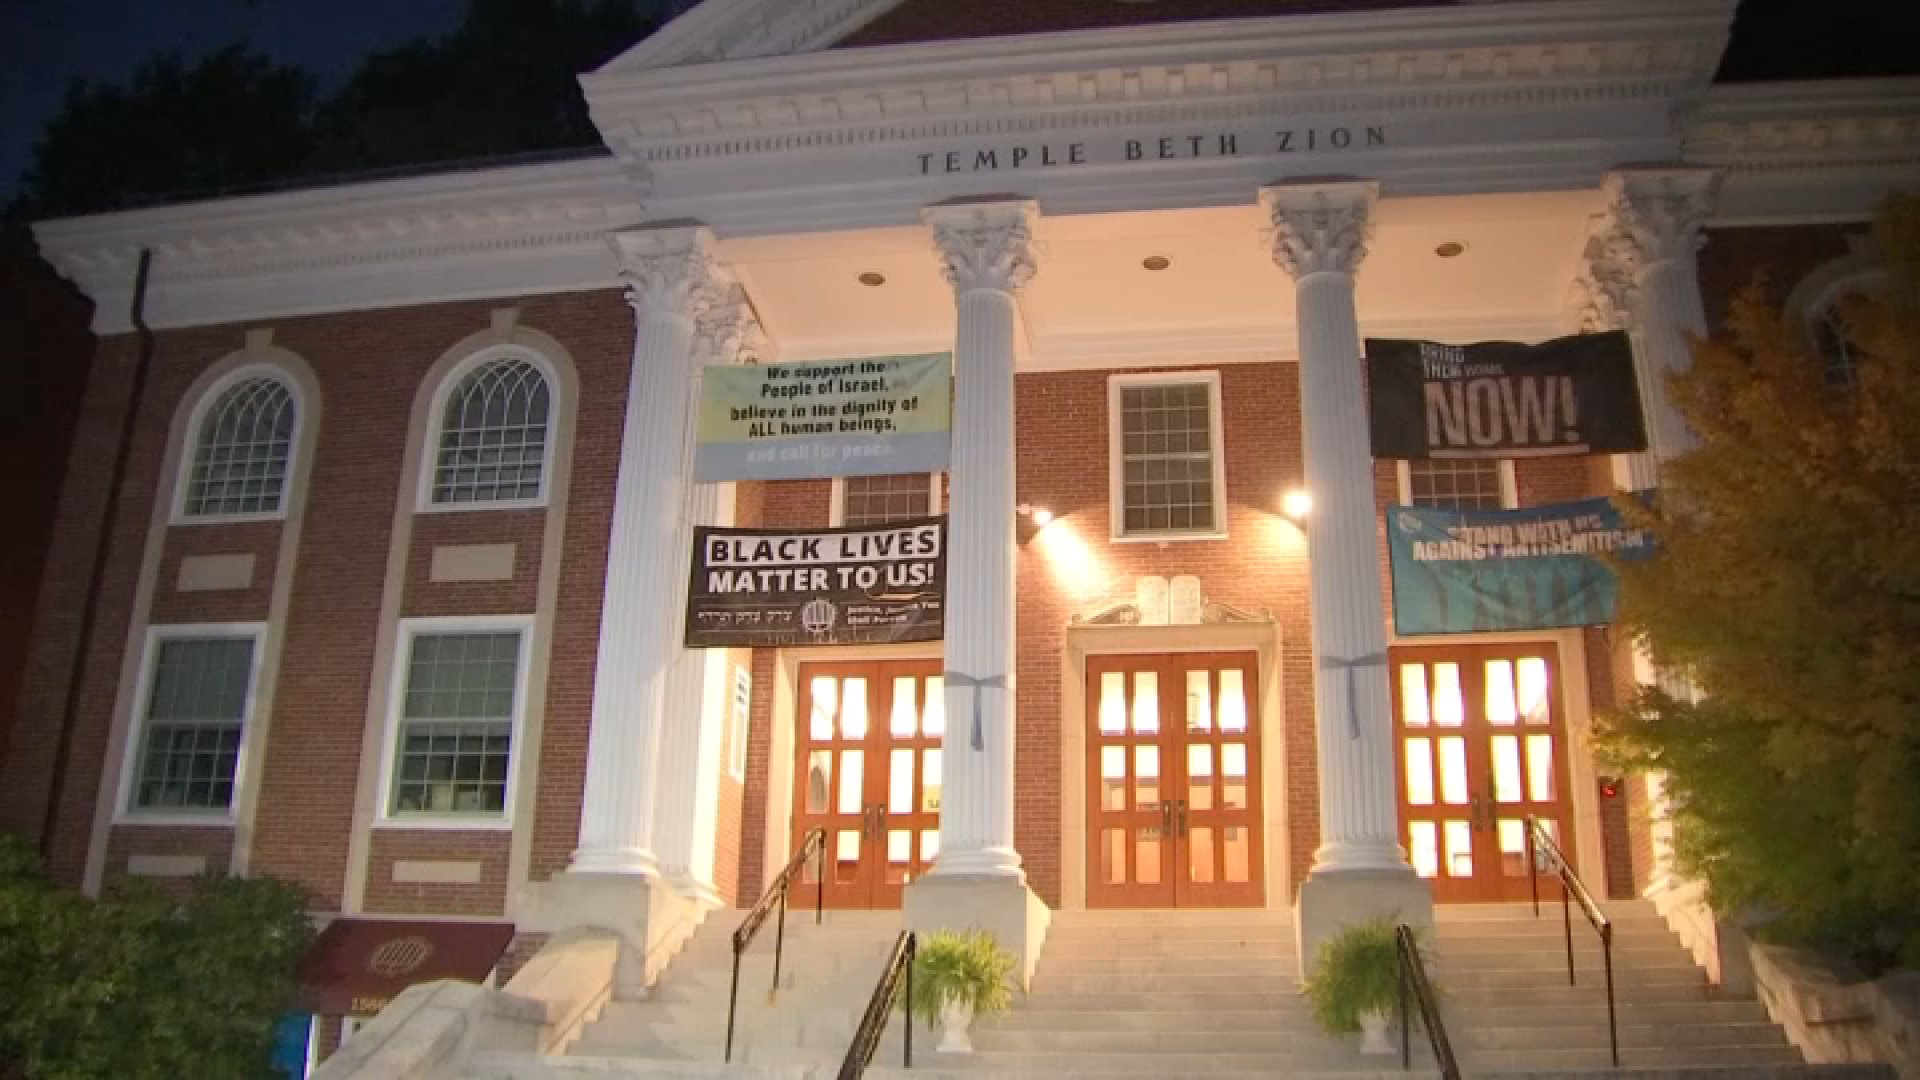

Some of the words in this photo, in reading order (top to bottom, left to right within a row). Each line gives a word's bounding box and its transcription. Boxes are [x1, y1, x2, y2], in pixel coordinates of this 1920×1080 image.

[918, 142, 1086, 174] TEMPLE
[1126, 132, 1238, 161] BETH
[1276, 126, 1386, 153] ZION
[767, 366, 790, 380] We
[794, 363, 854, 380] support
[860, 361, 887, 374] the
[761, 382, 812, 400] People
[818, 379, 833, 395] of
[730, 403, 788, 421] believe
[791, 404, 806, 418] in
[812, 404, 836, 418] the
[842, 397, 897, 417] dignity
[901, 395, 918, 411] of
[1424, 375, 1580, 447] NOW!
[749, 421, 776, 438] ALL
[780, 421, 833, 434] human
[711, 538, 820, 563] BLACK
[840, 530, 935, 558] LIVES
[709, 568, 829, 593] MATTER
[837, 565, 877, 589] TO
[887, 563, 934, 587] US!
